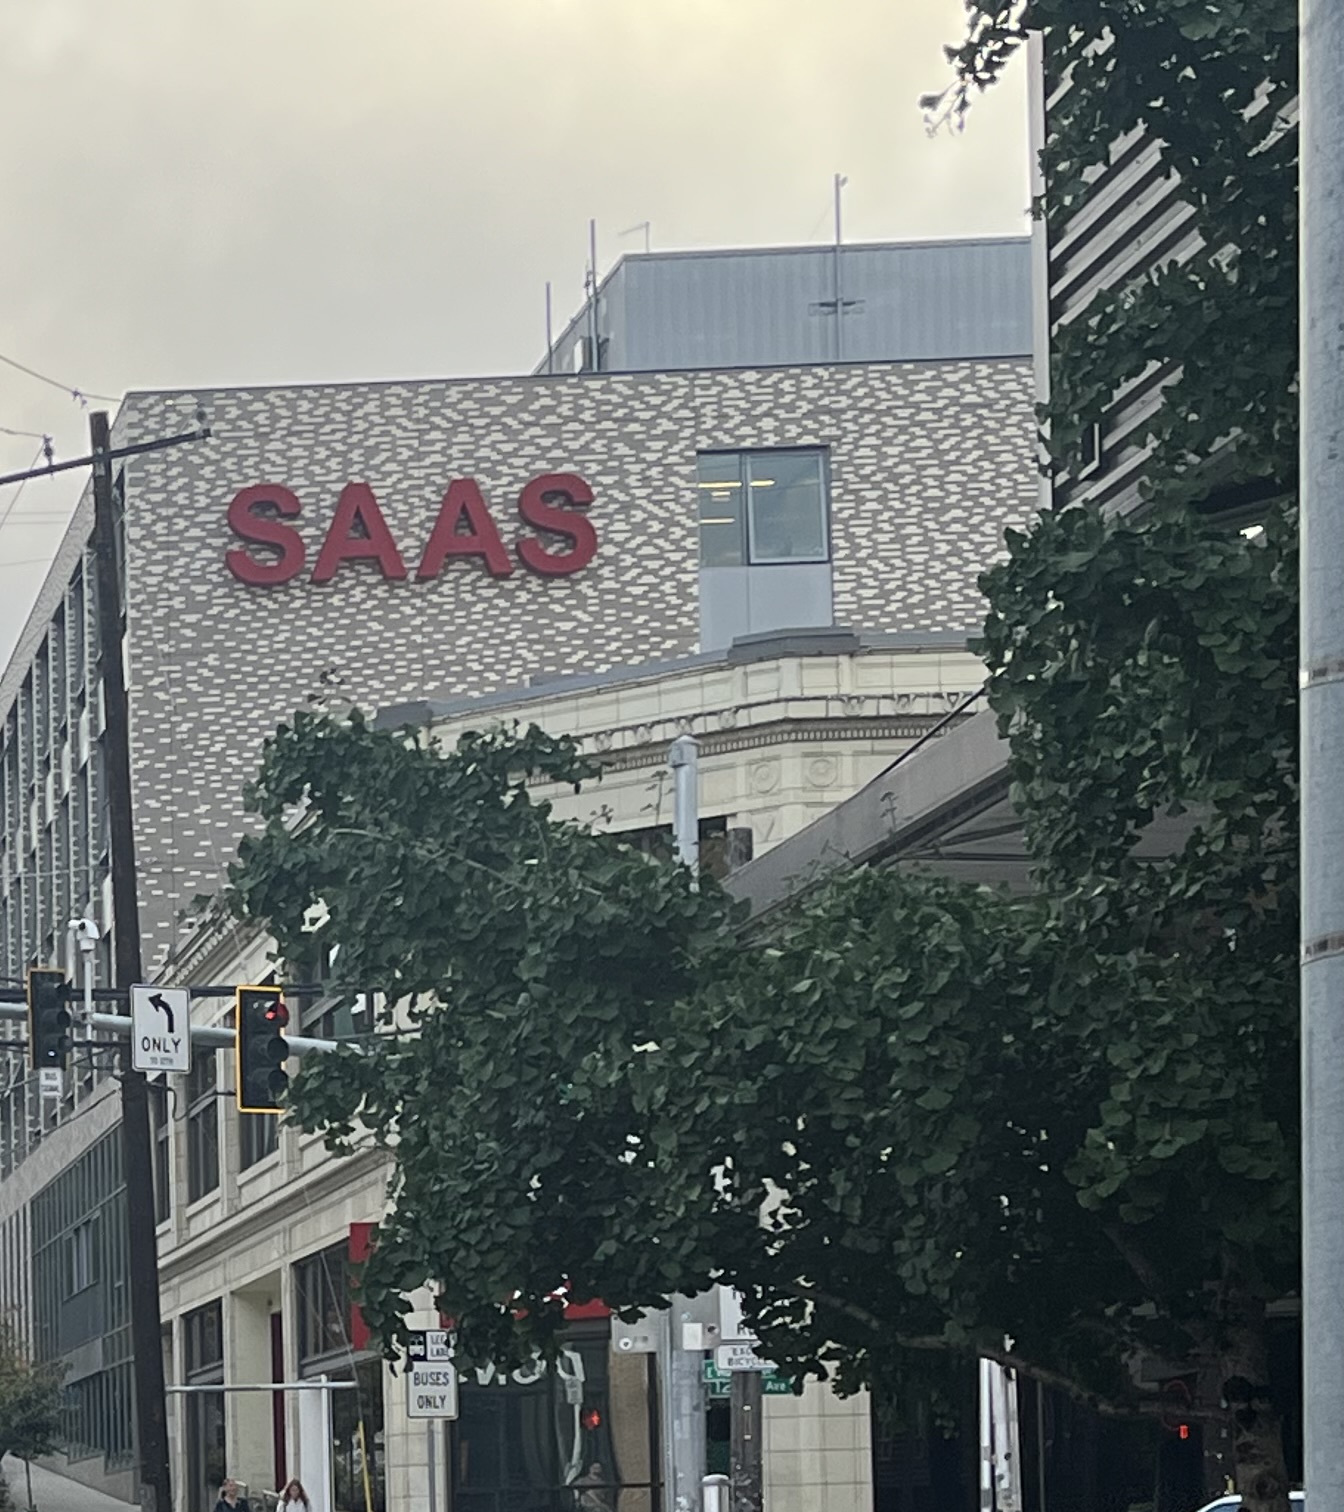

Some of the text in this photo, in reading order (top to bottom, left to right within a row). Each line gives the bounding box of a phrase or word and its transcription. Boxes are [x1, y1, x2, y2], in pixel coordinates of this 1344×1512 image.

[224, 472, 599, 587] SAAS
[141, 1036, 182, 1054] ONLY
[413, 1371, 450, 1387] BUSES
[416, 1394, 447, 1410] ONLY
